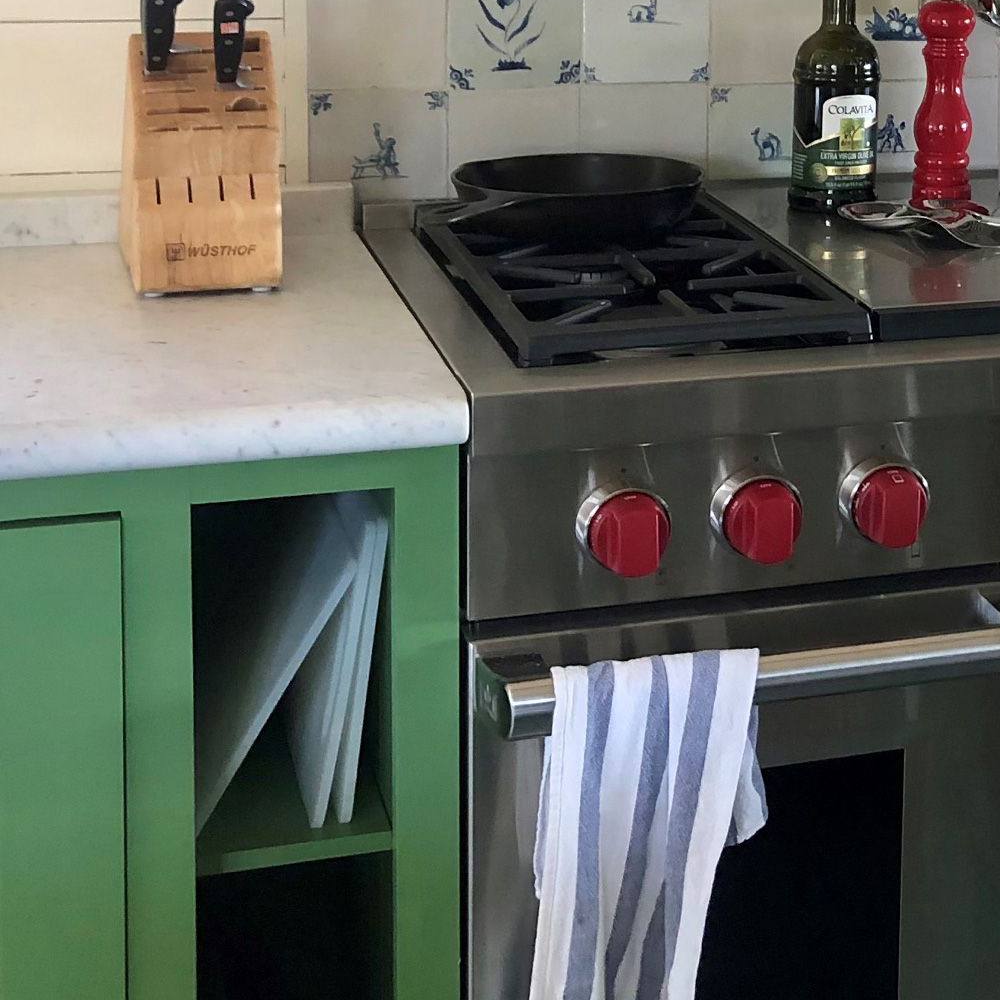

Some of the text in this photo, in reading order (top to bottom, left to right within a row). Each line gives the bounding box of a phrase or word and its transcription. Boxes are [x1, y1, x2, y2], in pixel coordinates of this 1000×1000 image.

[827, 104, 874, 115] COLAVITA
[820, 152, 838, 160] EXTRA
[839, 152, 857, 160] VIRGIN
